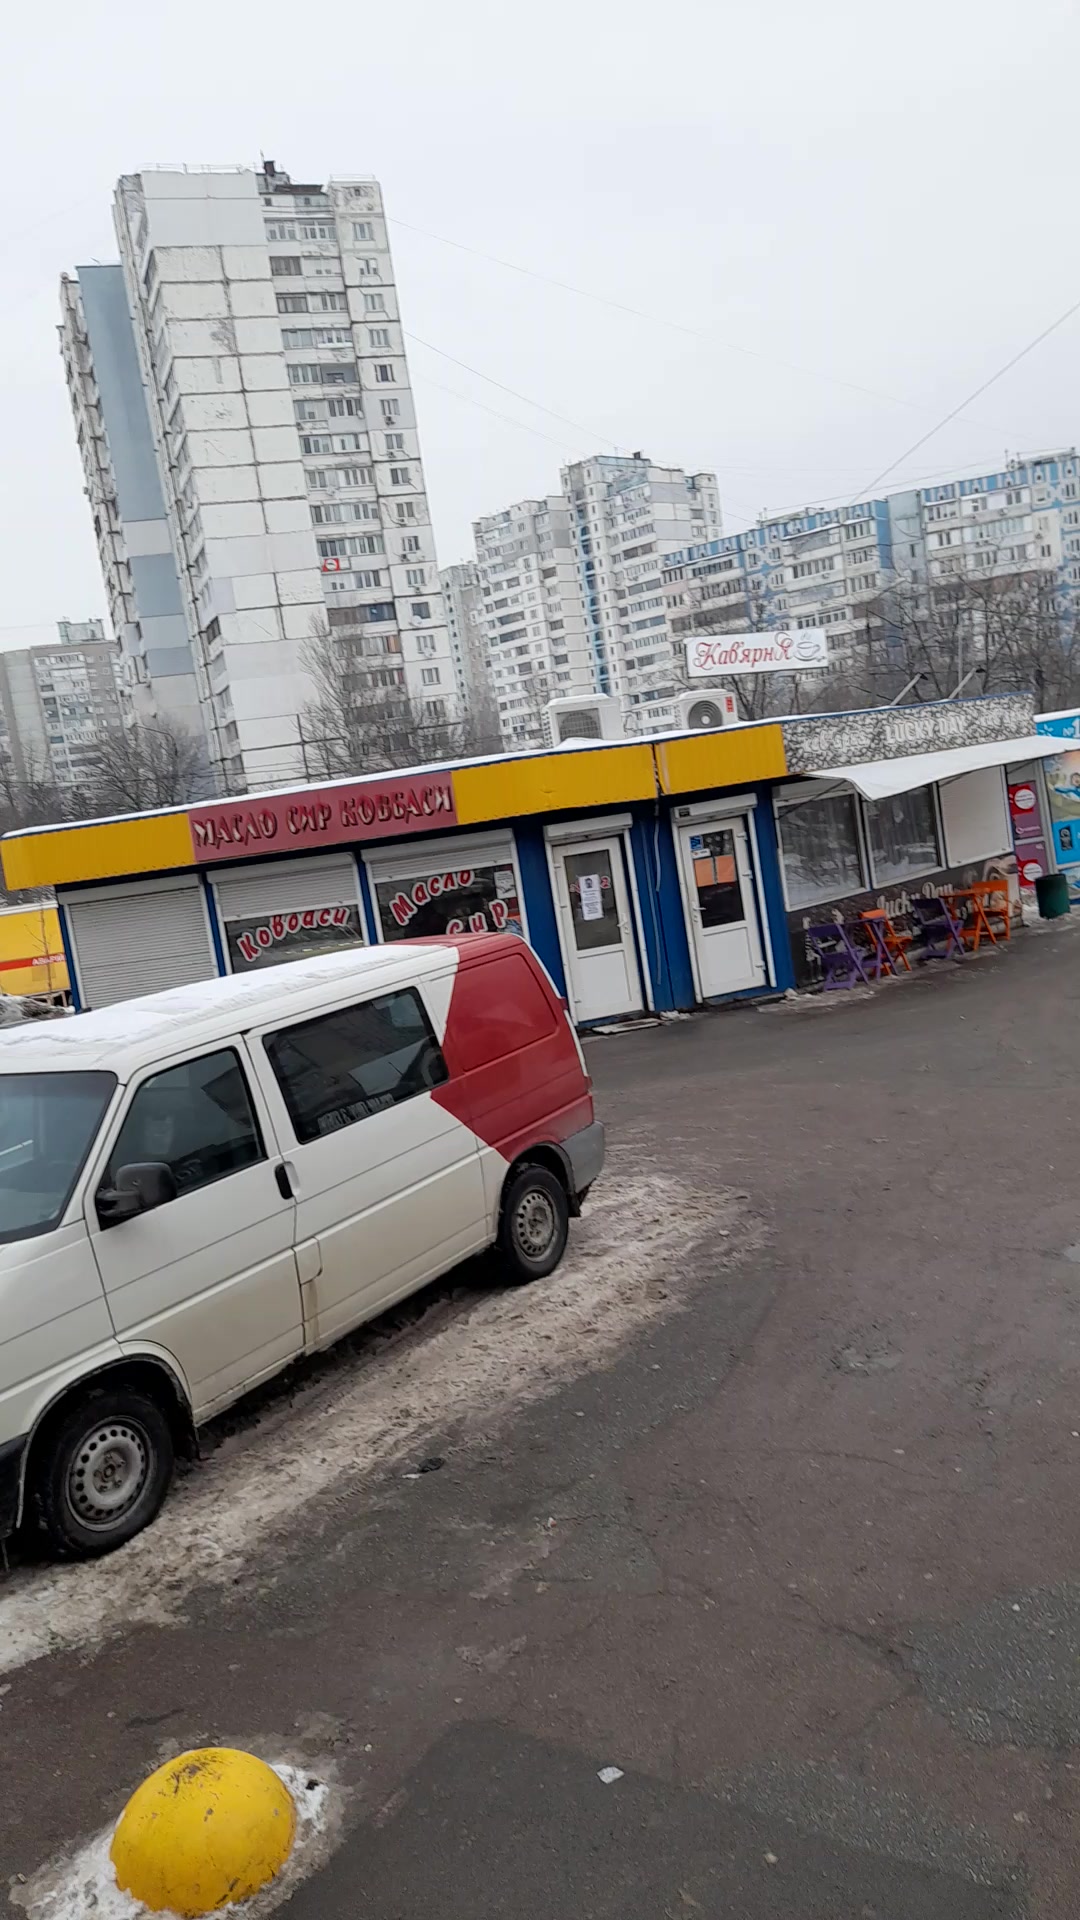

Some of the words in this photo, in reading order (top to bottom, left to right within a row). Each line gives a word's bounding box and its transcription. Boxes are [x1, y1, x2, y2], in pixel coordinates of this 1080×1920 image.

[192, 808, 278, 849] МАСЛО
[287, 802, 332, 835] СИР
[339, 785, 453, 827] КОВБАСИ
